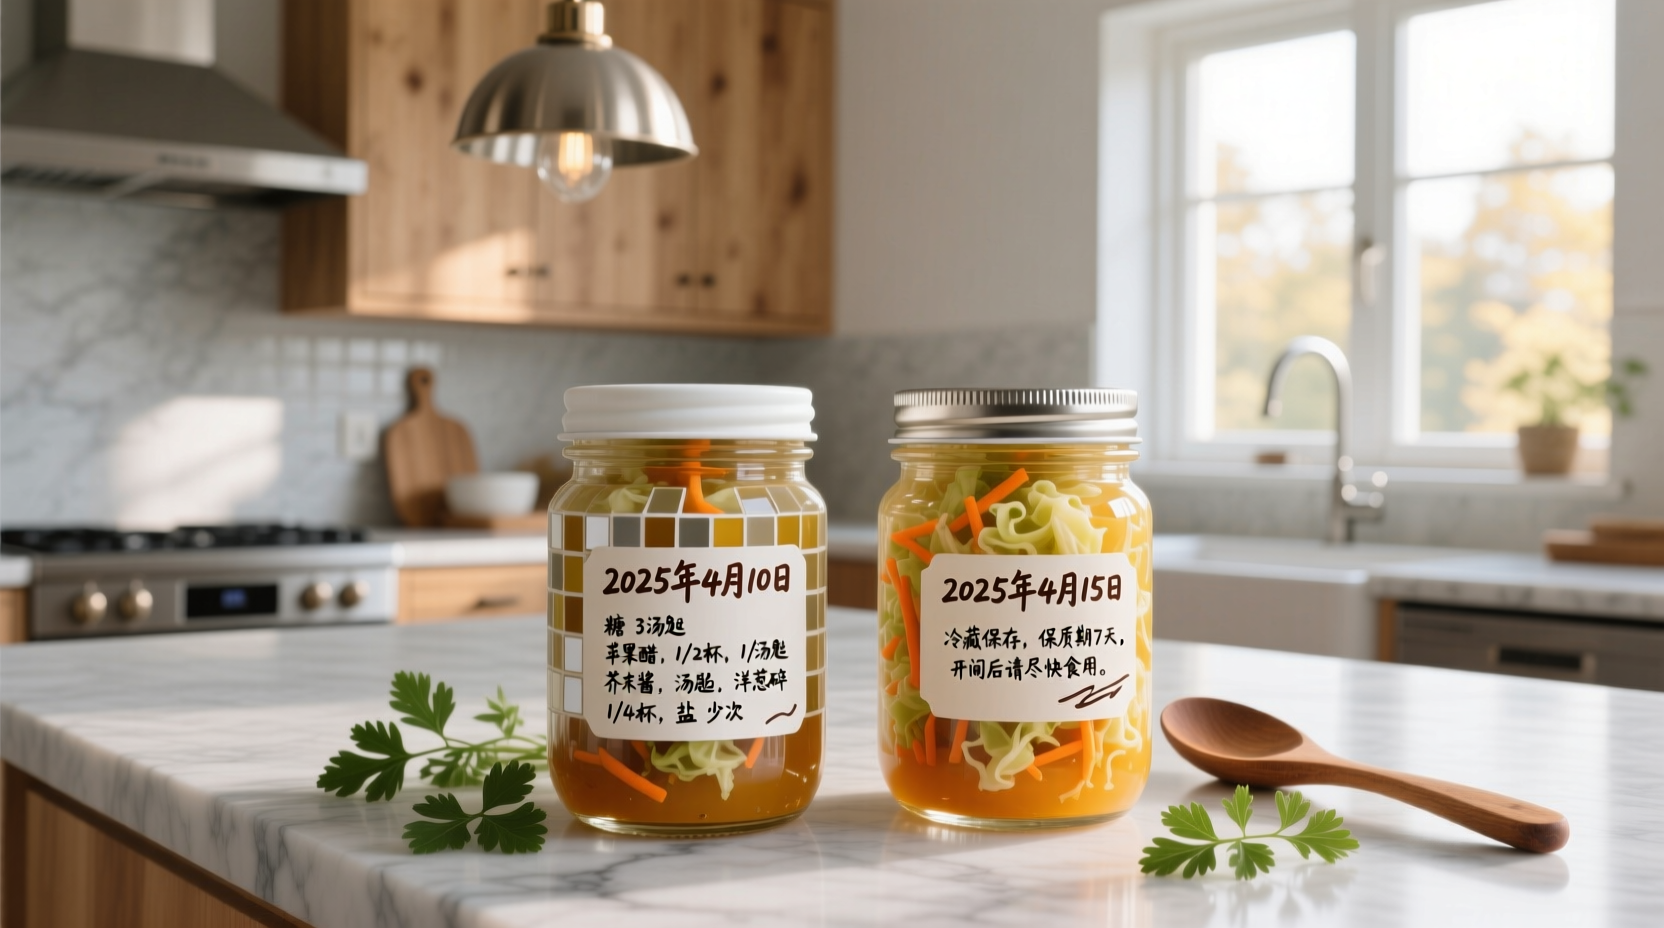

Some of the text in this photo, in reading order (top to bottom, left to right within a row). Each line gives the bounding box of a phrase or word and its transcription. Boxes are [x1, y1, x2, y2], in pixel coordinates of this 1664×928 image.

[602, 559, 791, 604] 2025年4月10日
[941, 569, 1122, 613] 2025年4月15日
[604, 613, 626, 637] 糖
